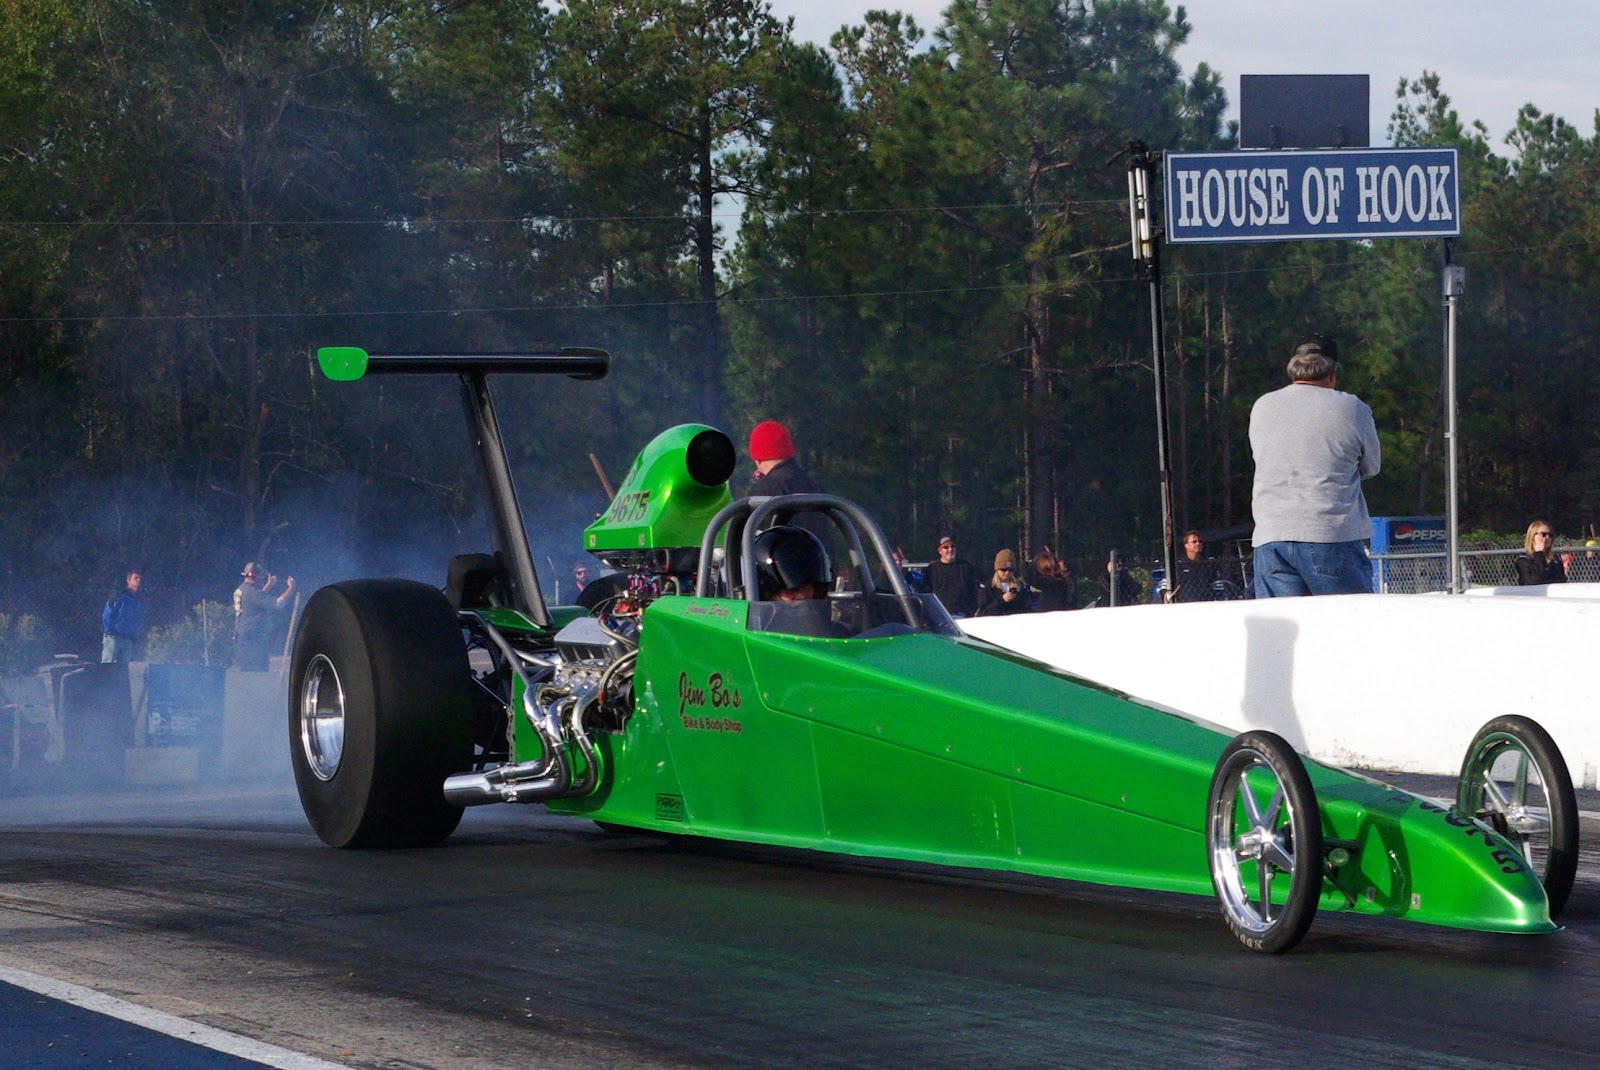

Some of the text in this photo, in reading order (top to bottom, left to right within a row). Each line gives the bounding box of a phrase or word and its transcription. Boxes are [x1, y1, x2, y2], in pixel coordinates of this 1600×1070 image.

[1176, 164, 1453, 227] HOUSE OF HOOK
[608, 491, 650, 523] 9675
[1411, 529, 1448, 541] PEPS
[679, 671, 742, 716] Jim Bo's
[705, 717, 723, 733] Body
[724, 718, 742, 734] Shop
